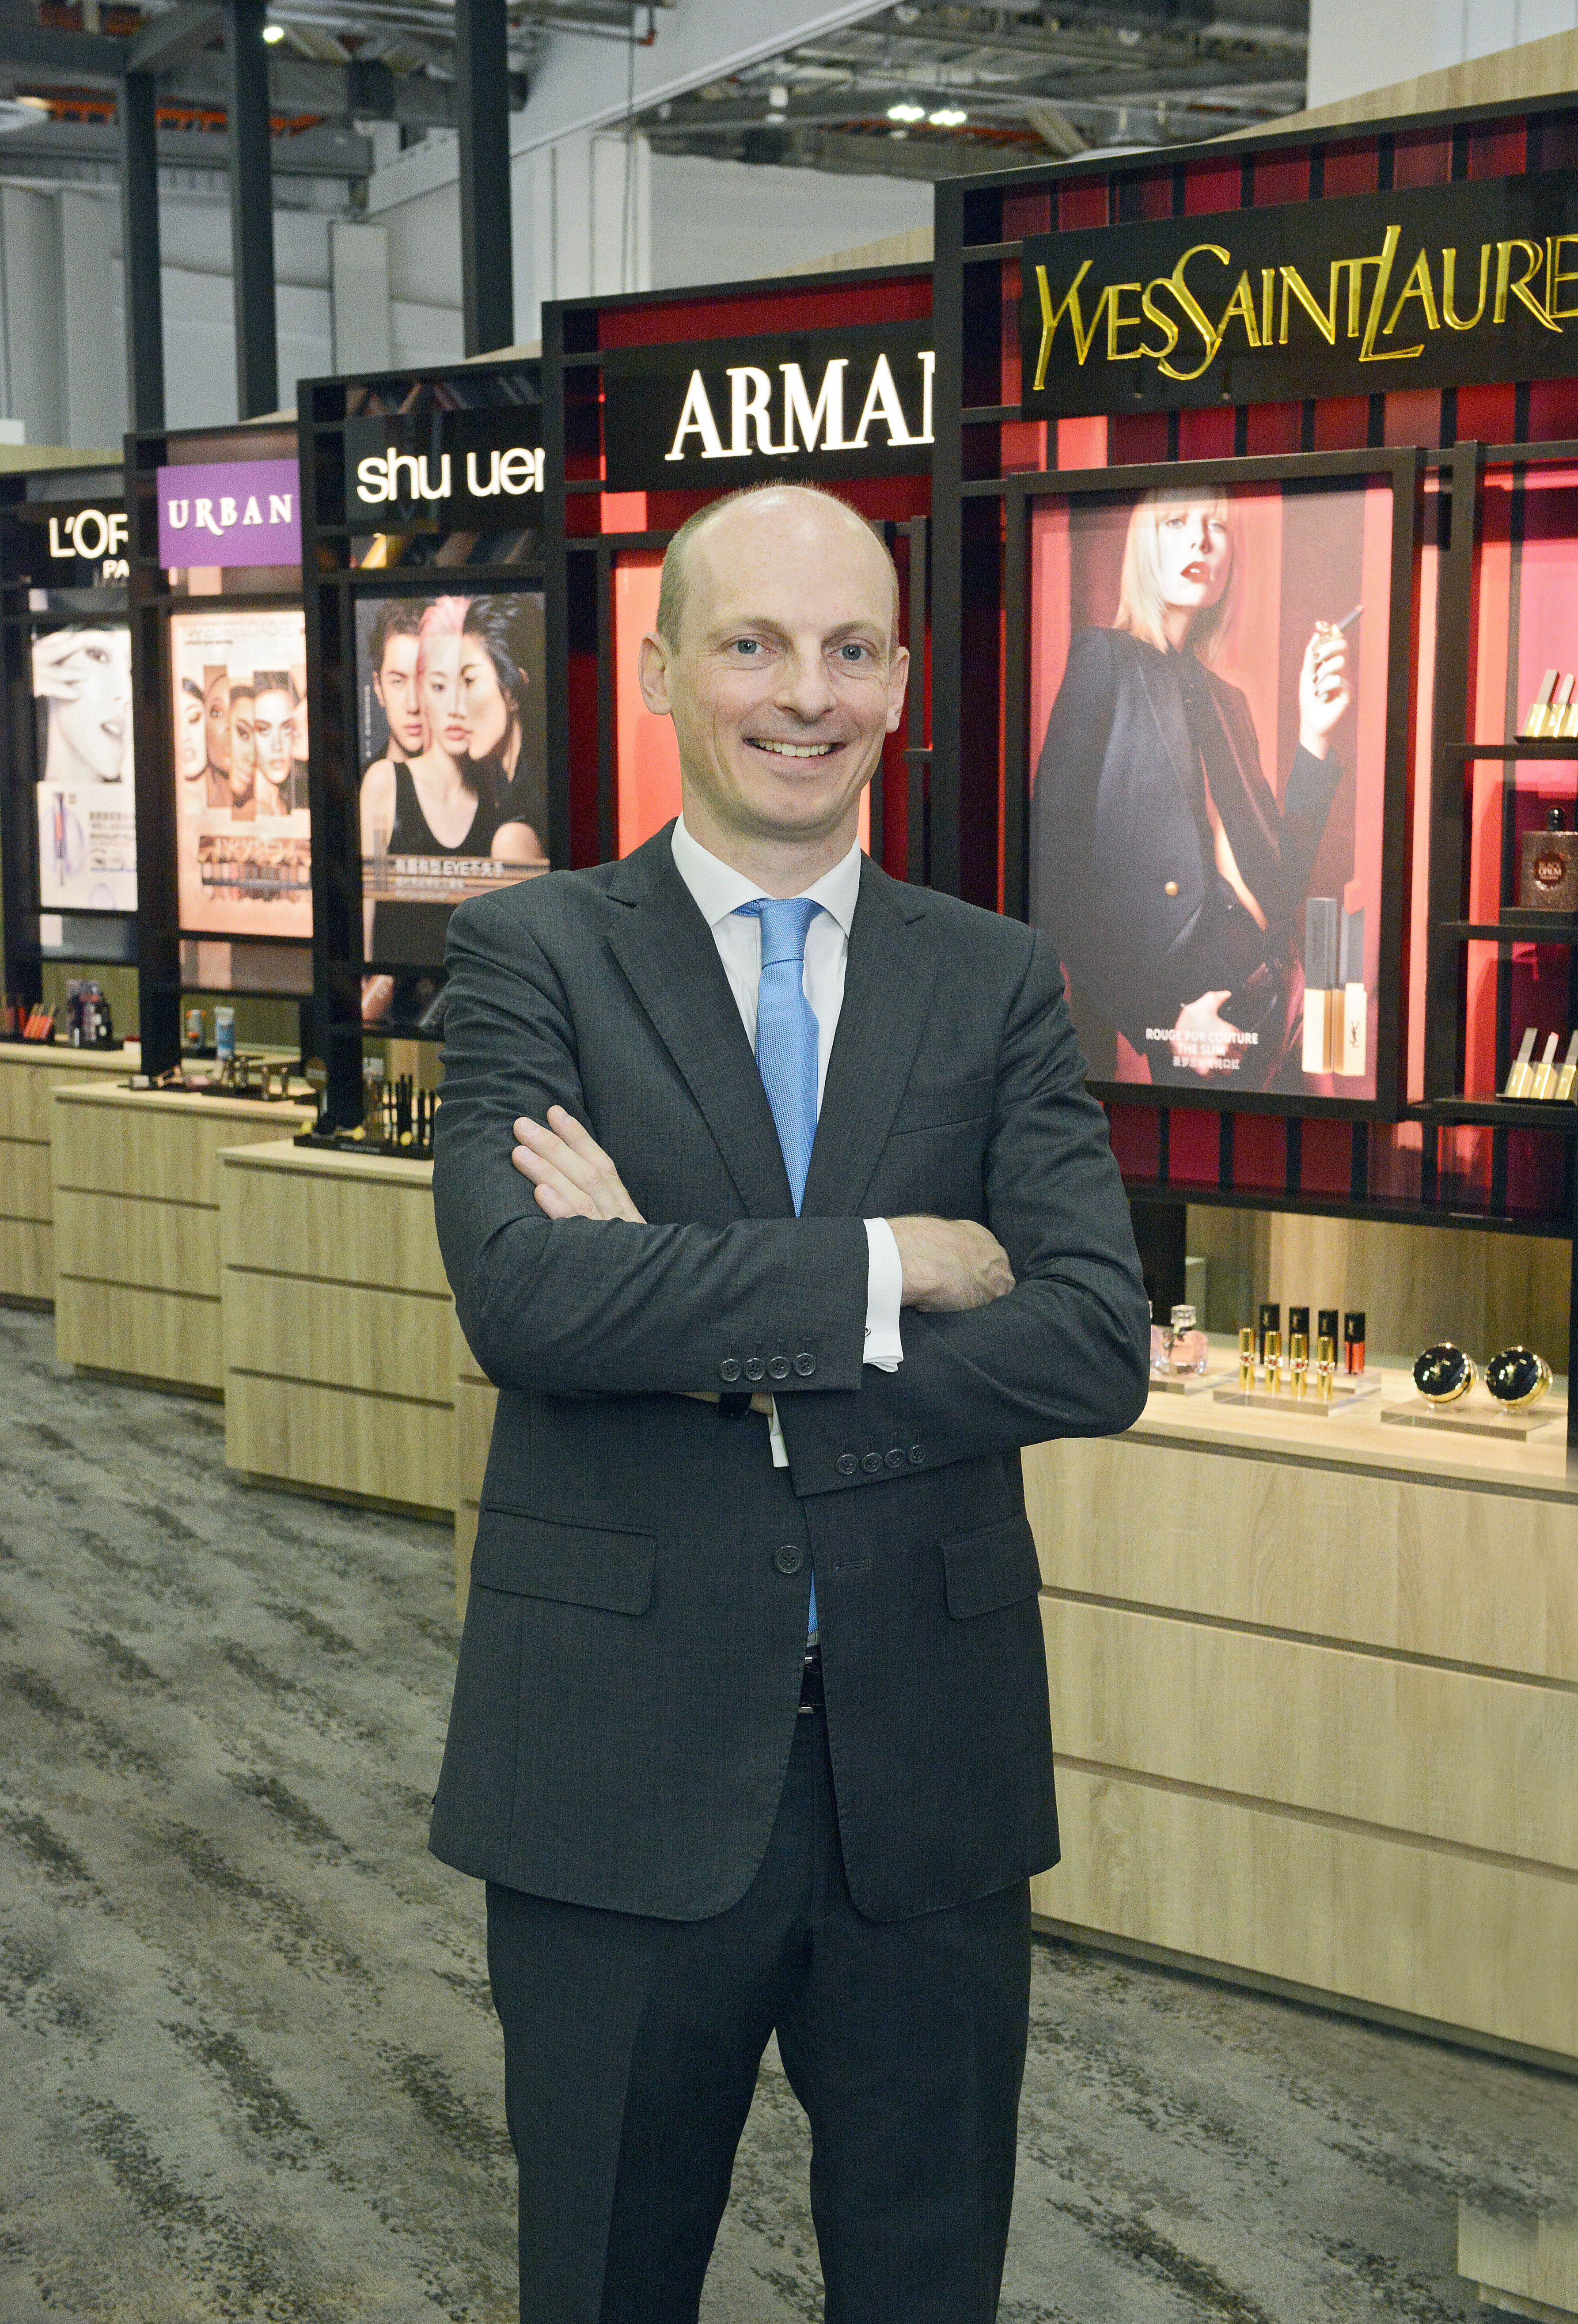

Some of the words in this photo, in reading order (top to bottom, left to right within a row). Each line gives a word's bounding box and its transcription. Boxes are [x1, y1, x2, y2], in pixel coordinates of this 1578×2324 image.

[357, 447, 451, 503] shu
[168, 494, 292, 535] URBAN
[1146, 1028, 1181, 1041] ROUGE
[1184, 1030, 1207, 1042] PUR
[1208, 1031, 1259, 1045] COUTURE
[1177, 1043, 1199, 1055] THE
[1200, 1043, 1228, 1056] SLIM
